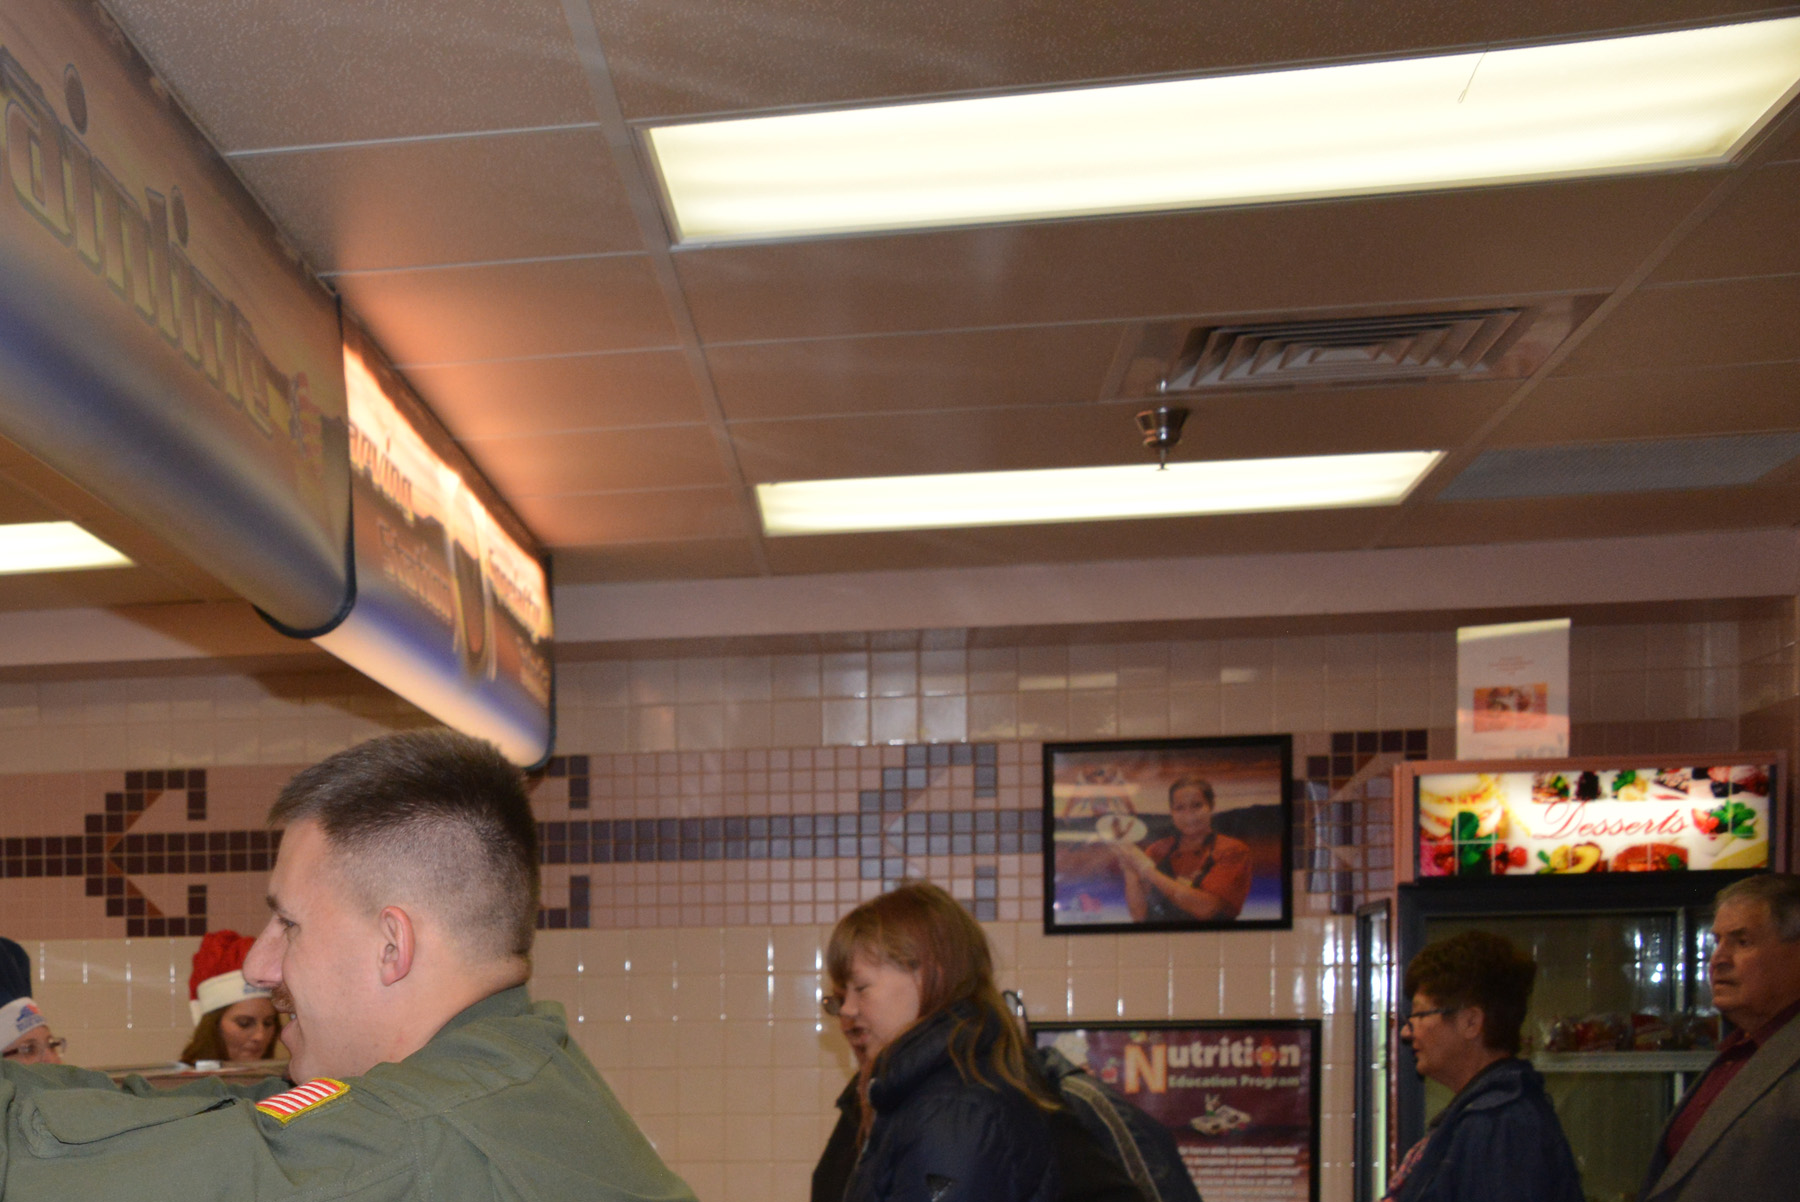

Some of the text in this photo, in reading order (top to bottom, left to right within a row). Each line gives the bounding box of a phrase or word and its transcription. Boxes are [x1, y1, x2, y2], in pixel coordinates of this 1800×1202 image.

[1532, 798, 1689, 840] Desserts
[1124, 1036, 1301, 1095] Nutrition
[1168, 1074, 1301, 1090] Education Program
